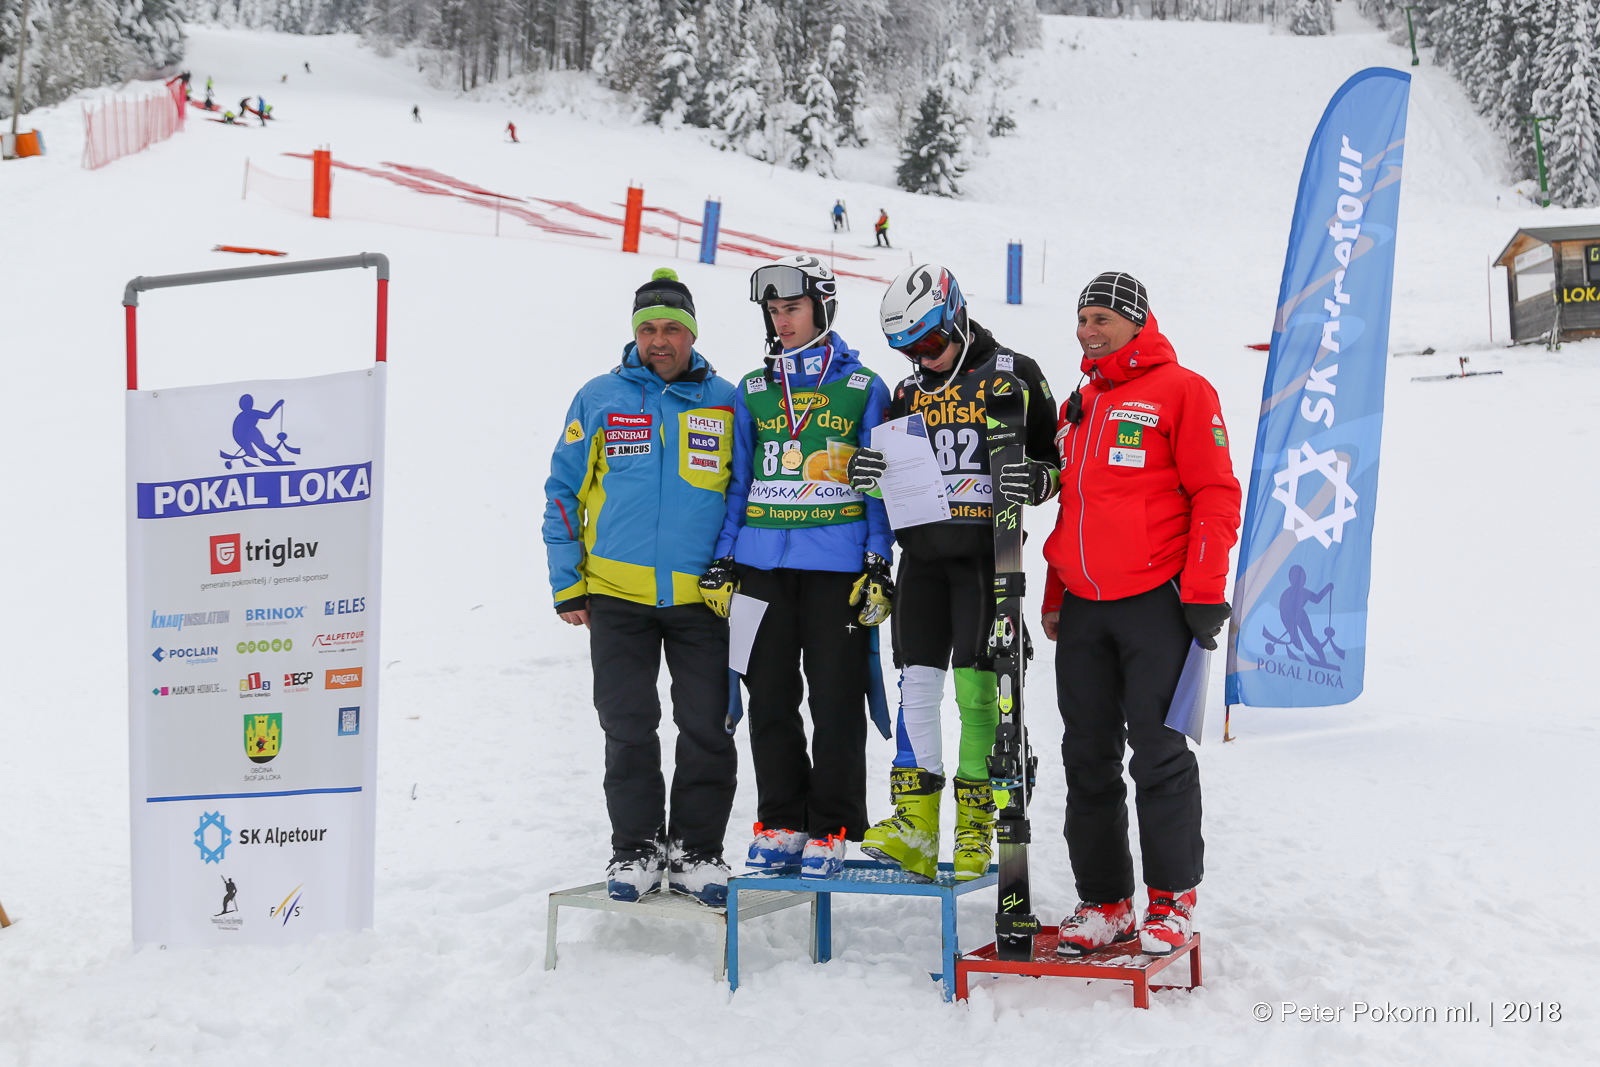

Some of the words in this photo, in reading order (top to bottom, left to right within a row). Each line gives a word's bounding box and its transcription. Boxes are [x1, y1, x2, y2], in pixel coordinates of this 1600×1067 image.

[1563, 286, 1600, 303] LOK
[910, 380, 962, 411] Jack
[1301, 363, 1338, 429] SK
[1122, 401, 1156, 411] PETROL
[612, 416, 648, 424] PETROL
[923, 401, 986, 427] olfsk
[1111, 412, 1158, 425] TENSON
[690, 416, 722, 429] HALTI
[817, 410, 854, 437] day
[606, 430, 649, 440] GENERALI
[618, 444, 650, 455] AMICUS
[692, 438, 708, 447] NLB
[935, 428, 982, 471] 82
[154, 476, 268, 515] POKAL
[280, 467, 370, 505] LOKA
[769, 507, 808, 521] happy
[811, 507, 836, 521] day
[950, 505, 991, 518] olfski
[246, 537, 319, 568] triglav
[273, 574, 301, 586] general
[302, 573, 329, 583] sponsor
[338, 597, 366, 615] ELES
[246, 606, 305, 621] BRINOX
[325, 631, 364, 641] ALPETOUR
[169, 646, 218, 658] POCLAIN
[293, 671, 313, 685] BGP
[1257, 658, 1302, 680] POKAL
[1308, 669, 1344, 689] LOKA
[249, 675, 258, 689] 1
[239, 828, 260, 844] SK
[264, 826, 327, 847] Alpetour
[1003, 893, 1023, 912] SL
